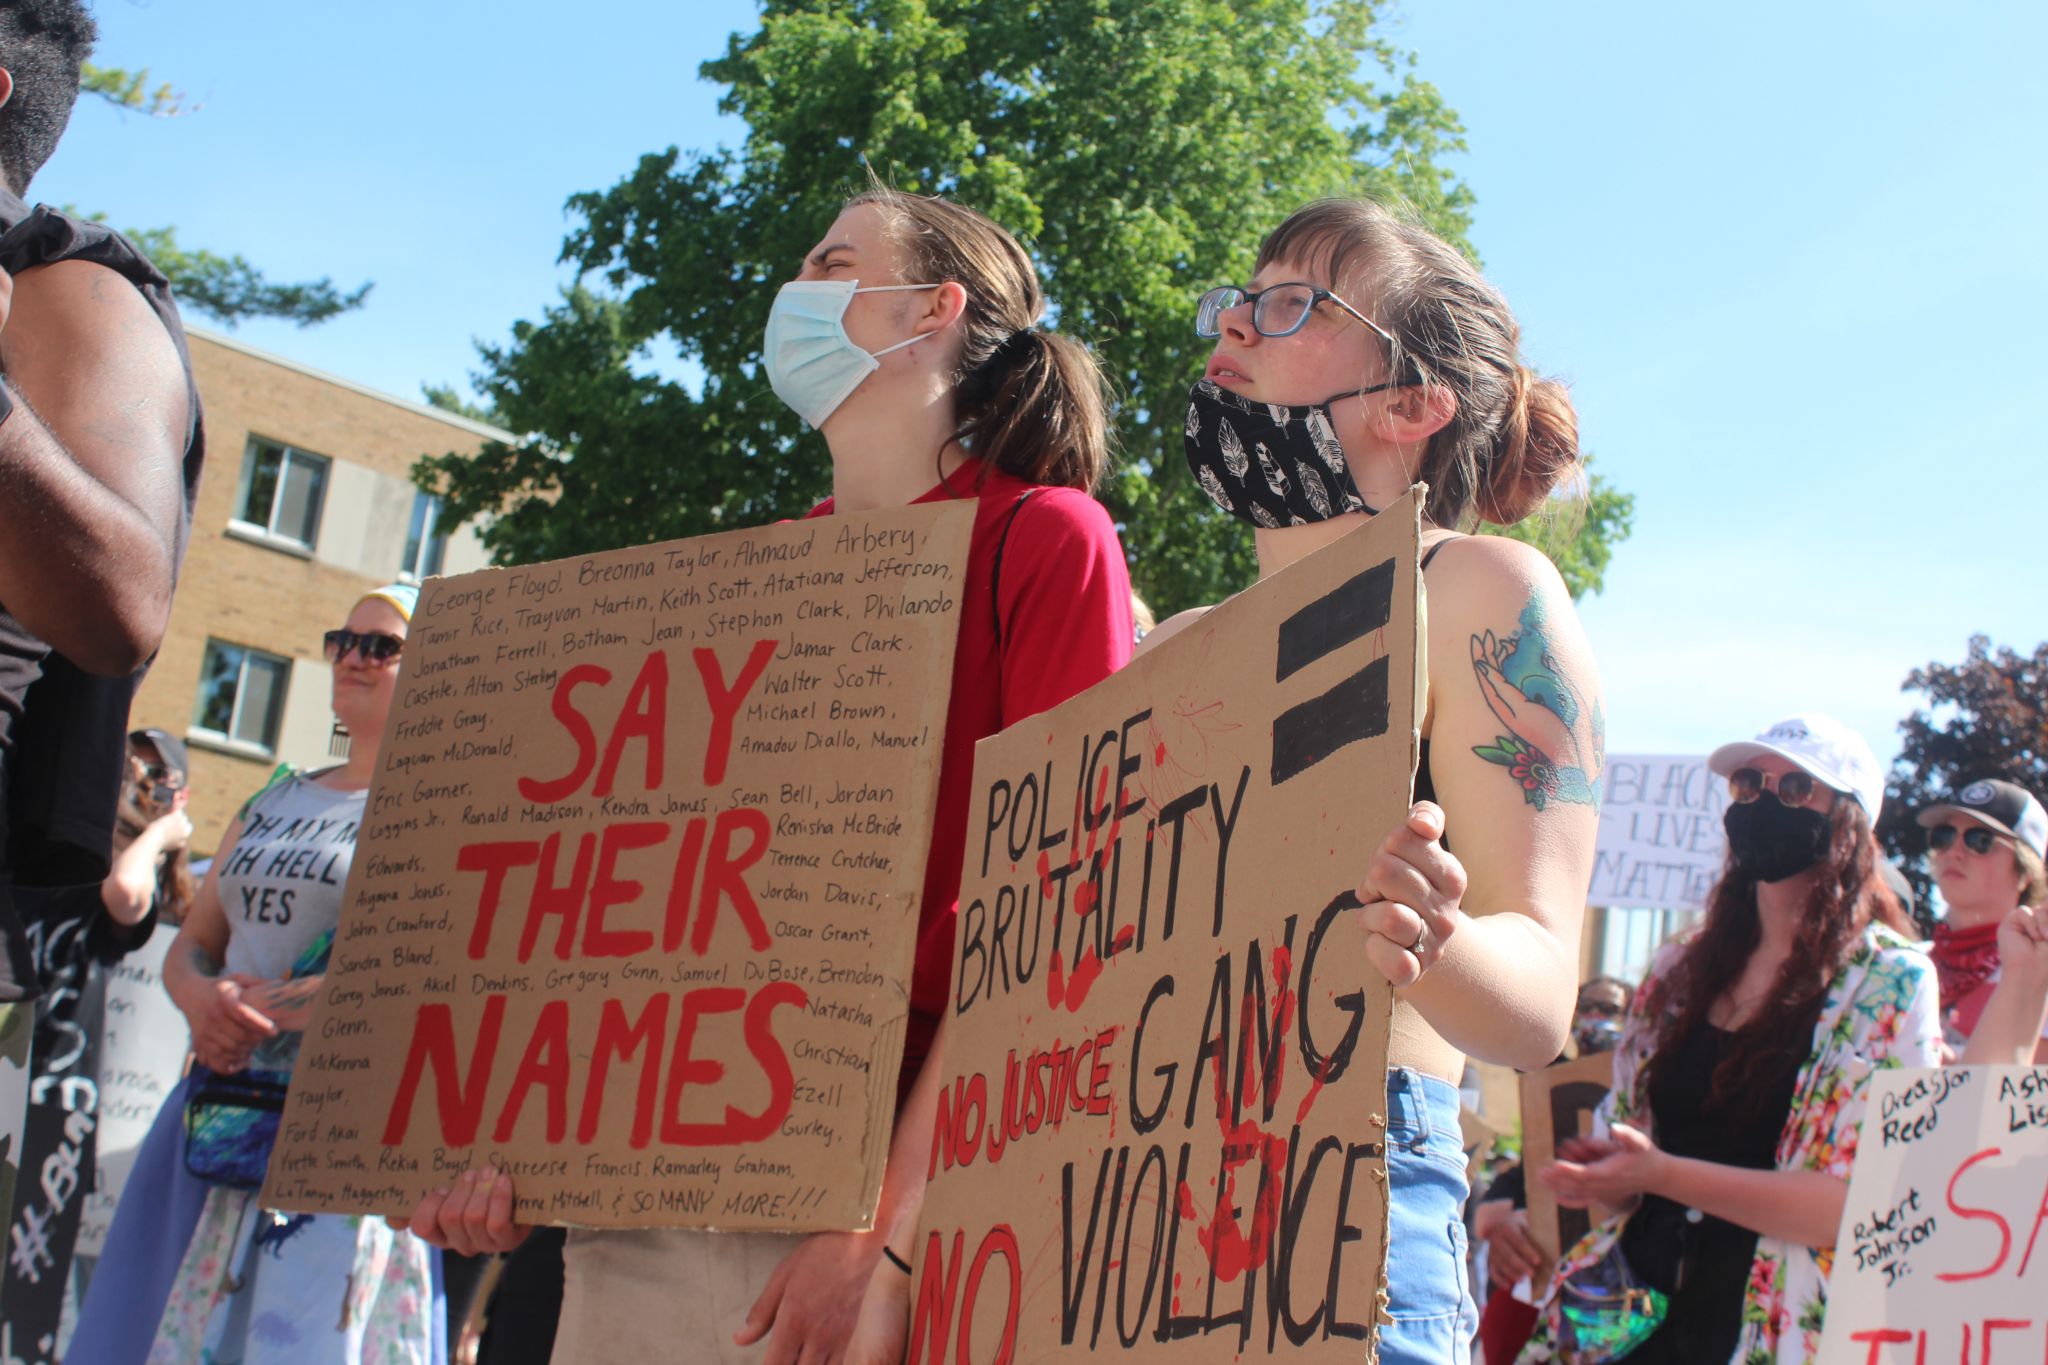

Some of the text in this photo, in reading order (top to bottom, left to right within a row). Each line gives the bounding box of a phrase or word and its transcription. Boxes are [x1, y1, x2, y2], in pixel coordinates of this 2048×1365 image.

[426, 525, 926, 615] George Floyd, Breonna Taylor, Ahmaud Arbery,
[417, 559, 953, 647] Tamir Rice, Trayvon Martin, Keith Scott, Atatiana Jefferson,
[412, 591, 953, 679] Jonathan Ferrell, Botham Jean, Stephon Clark, Philando
[776, 631, 836, 659] Jamar
[404, 680, 457, 708] Castile,
[464, 675, 503, 696] Alton
[764, 670, 823, 695] Walter
[518, 640, 778, 803] SAY
[747, 701, 815, 721] Michael
[395, 718, 443, 741] Freddie
[740, 726, 928, 753] Amadou Diallo, Manuel
[386, 752, 435, 774] Laquan
[373, 786, 403, 815] Eric
[982, 707, 1153, 878] POLICE
[369, 816, 418, 840] Loggins
[462, 805, 509, 824] Ronald
[520, 804, 592, 823] Madison,
[601, 796, 649, 816] Kendra
[660, 794, 718, 815] James,
[729, 788, 768, 810] Sean
[780, 783, 818, 809] Bell,
[826, 781, 894, 805] Jordan
[776, 810, 903, 837] Renisha McBride
[265, 850, 339, 885] HELL
[769, 850, 892, 874] Terrence Crutcher,
[456, 808, 772, 964] THEIR
[760, 880, 881, 911] Jordan Davis,
[956, 765, 1250, 1018] BRUTALITY
[240, 886, 296, 925] YES
[345, 910, 453, 941] John Crawford,
[774, 921, 873, 948] Oscar Grant,
[336, 954, 380, 976] Sandra
[423, 974, 456, 993] Akiel
[545, 969, 609, 992] Gregory
[621, 962, 663, 983] Gunn,
[676, 963, 727, 984] Samuel
[818, 960, 884, 986] Brendon
[802, 997, 874, 1028] Natasha
[1129, 888, 1366, 1135] GANG
[381, 981, 808, 1150] NAMES
[793, 1039, 870, 1073] Christian
[792, 1077, 843, 1108] Ezell
[928, 1026, 1118, 1182] NO JUSTICE
[781, 1115, 842, 1147] Gurley,
[1883, 1102, 1938, 1148] Reed
[378, 1147, 418, 1172] Rekia
[734, 1153, 795, 1180] Graham,
[1854, 1187, 1919, 1242] Robert
[1062, 1124, 1383, 1353] VIOLENCE
[907, 1223, 1022, 1365] NO
